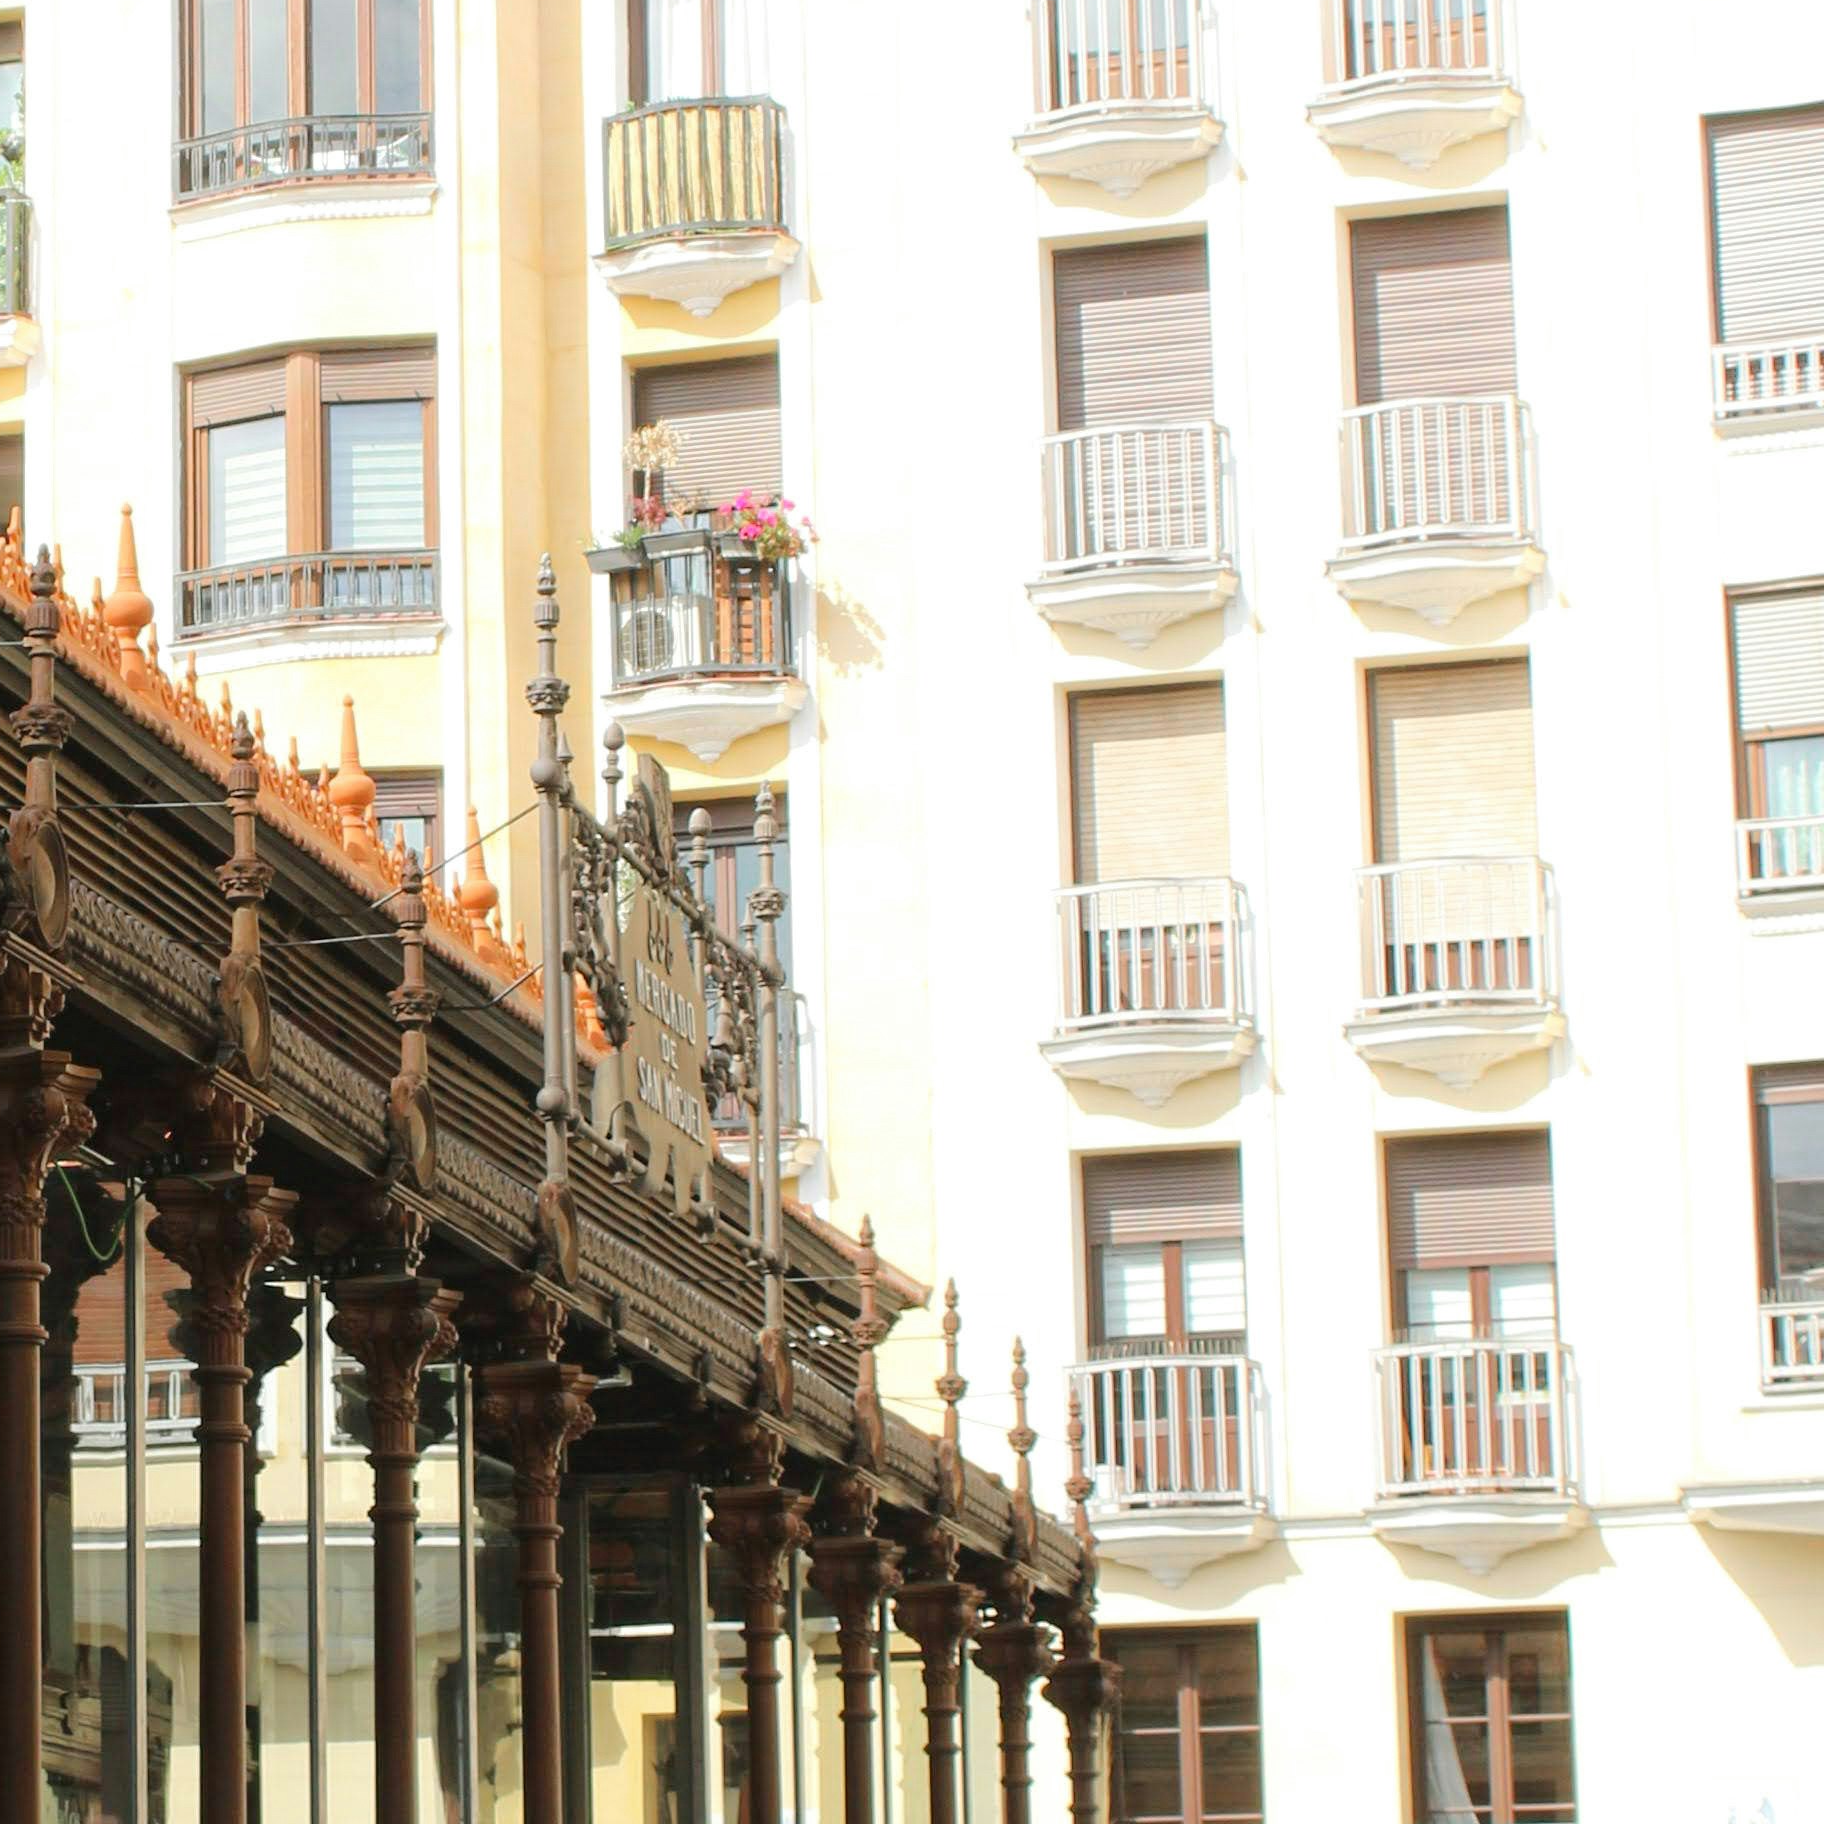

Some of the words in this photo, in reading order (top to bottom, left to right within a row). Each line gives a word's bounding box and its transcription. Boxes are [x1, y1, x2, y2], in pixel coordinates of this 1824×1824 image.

[635, 959, 697, 1046] MERCADO
[660, 1032, 679, 1070] DE
[637, 1055, 663, 1114] SAN
